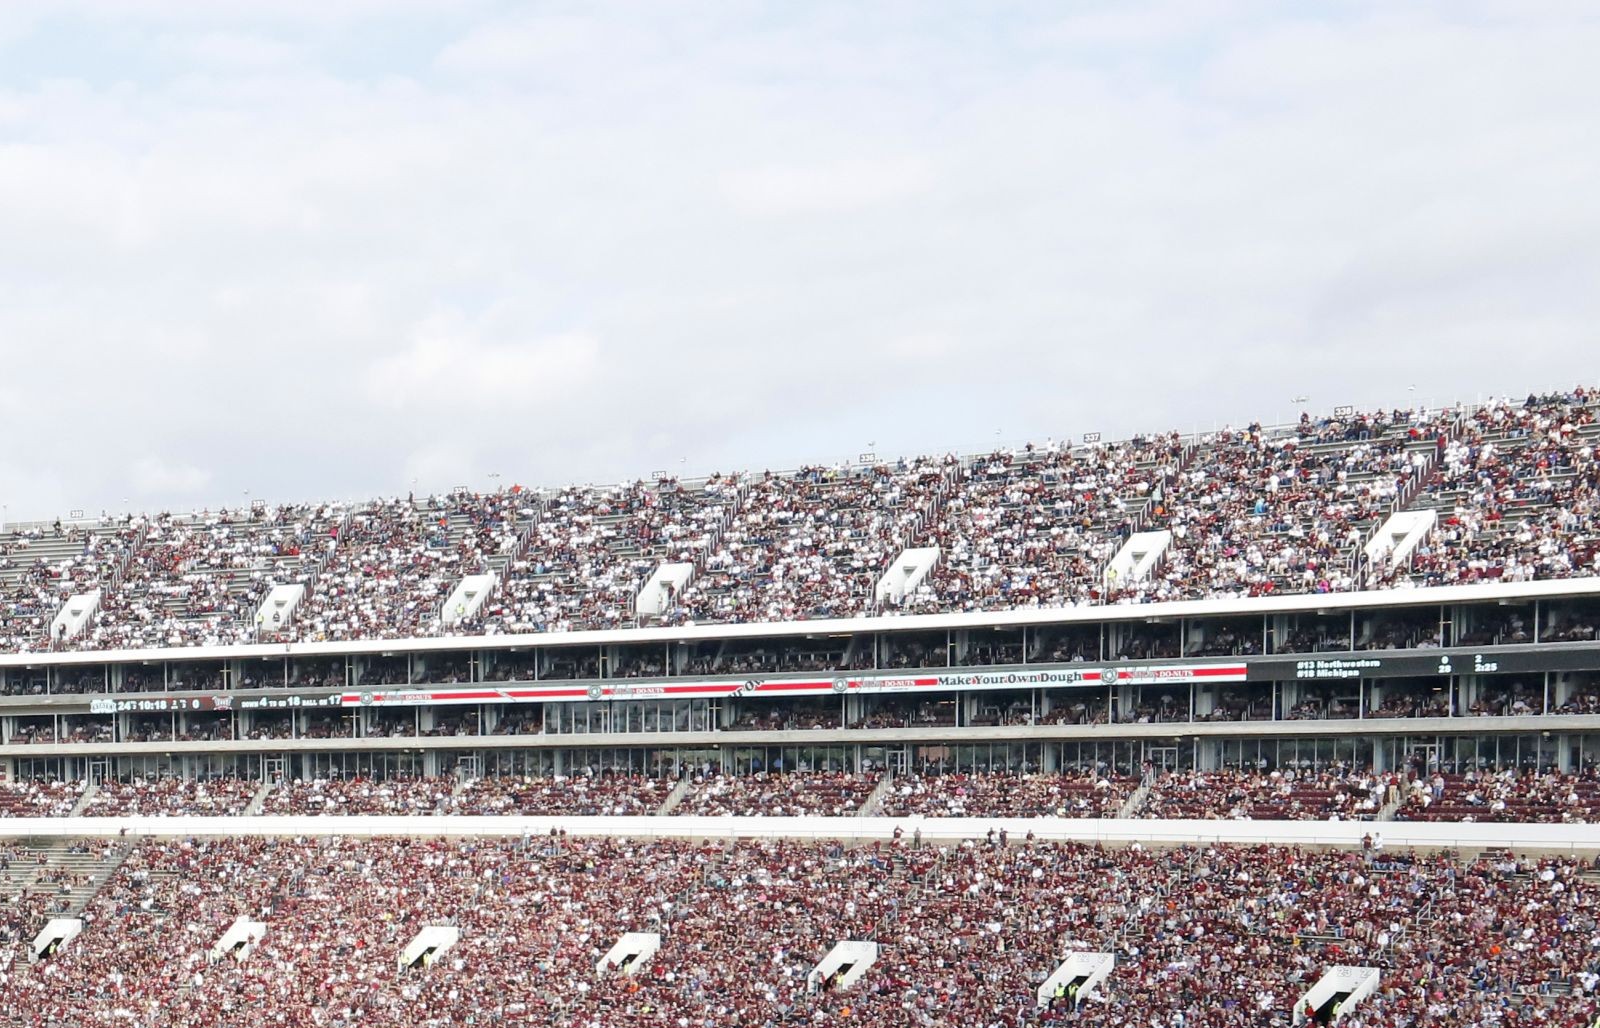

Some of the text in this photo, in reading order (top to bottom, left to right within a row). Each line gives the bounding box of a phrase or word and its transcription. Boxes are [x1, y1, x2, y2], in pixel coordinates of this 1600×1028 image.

[1317, 660, 1381, 669] Northwestern
[1475, 655, 1482, 663] 2
[938, 671, 1082, 686] Make Your Own Dough
[1317, 668, 1360, 678] Michigan
[118, 700, 131, 711] 24
[139, 700, 167, 711] 10:18
[260, 697, 267, 707] 4
[288, 696, 300, 706] 18
[329, 695, 342, 705] 17
